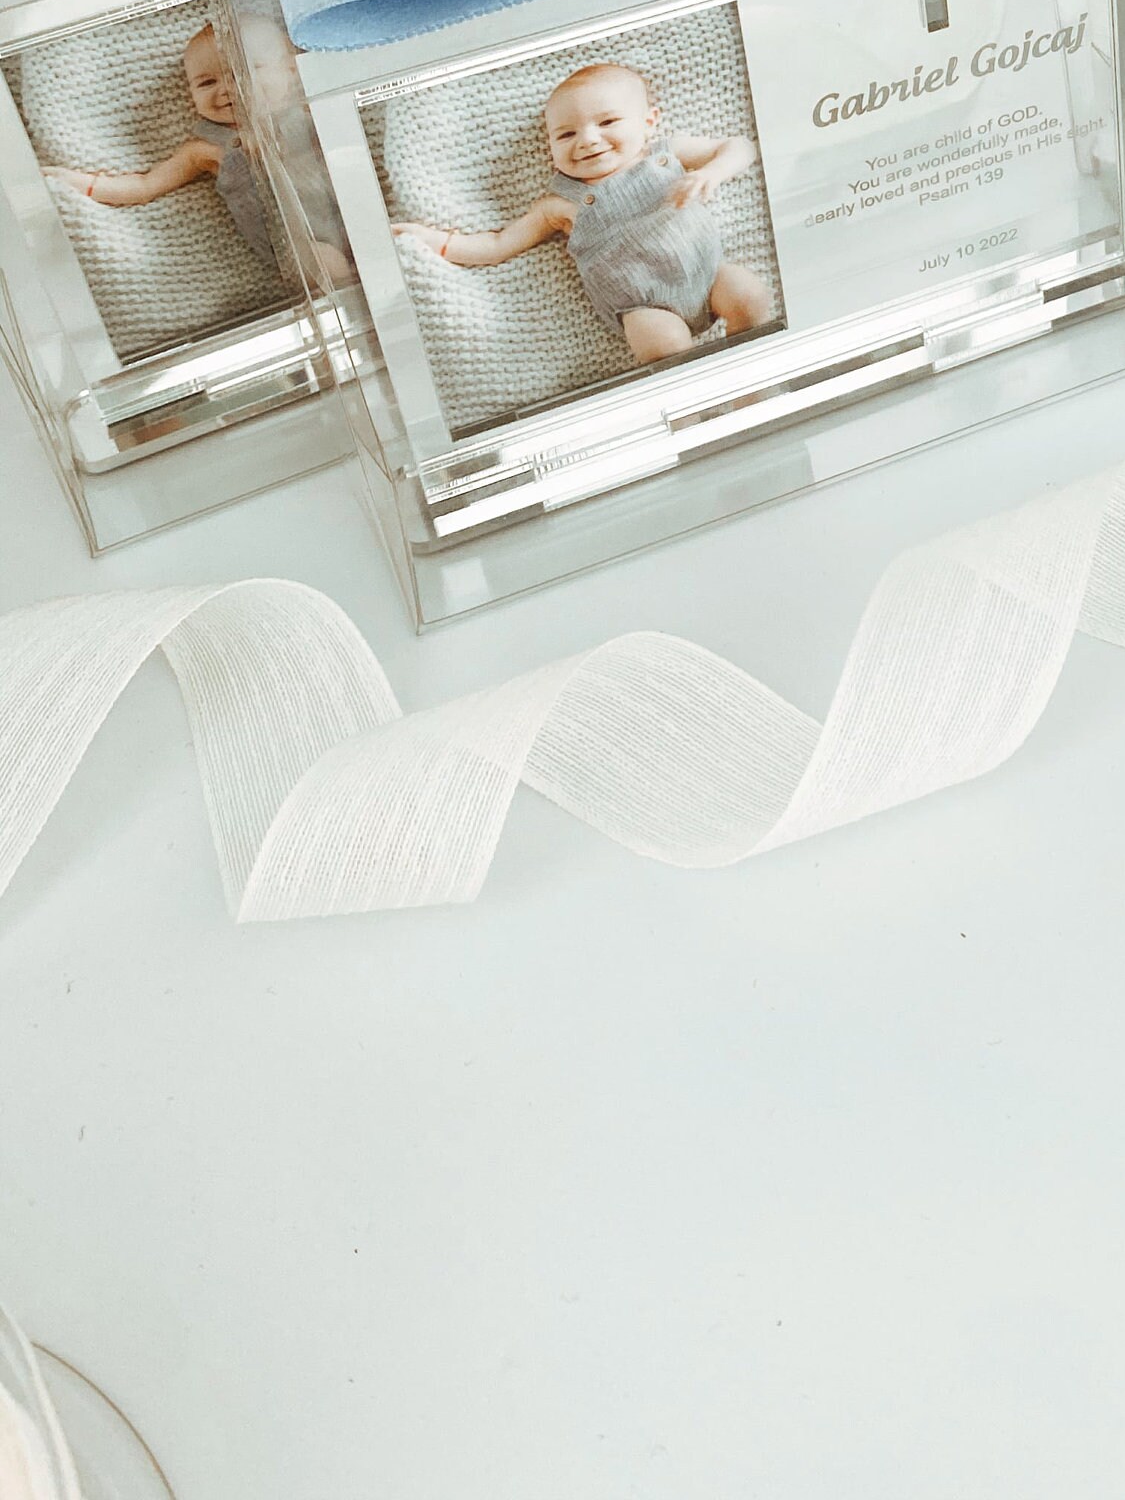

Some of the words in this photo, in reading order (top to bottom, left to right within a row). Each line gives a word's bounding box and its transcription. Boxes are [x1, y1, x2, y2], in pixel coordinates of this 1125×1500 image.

[812, 56, 960, 128] Gabriel
[970, 12, 1088, 77] Gojcaj
[848, 177, 880, 194] You
[886, 166, 912, 183] are
[917, 132, 1009, 172] wonderfully
[1014, 116, 1063, 141] made,
[860, 184, 905, 209] loved
[910, 172, 940, 192] and
[945, 150, 1013, 183] precious
[1036, 132, 1062, 150] His
[1067, 117, 1108, 139] sight.
[865, 153, 898, 171] You
[903, 143, 929, 160] are
[935, 126, 972, 149] child
[977, 119, 993, 134] of
[997, 105, 1043, 128] GOD.
[919, 181, 969, 206] Psalm
[975, 167, 1004, 186] 139
[919, 253, 950, 273] July
[956, 244, 975, 259] 10
[979, 228, 1018, 251] 2022
